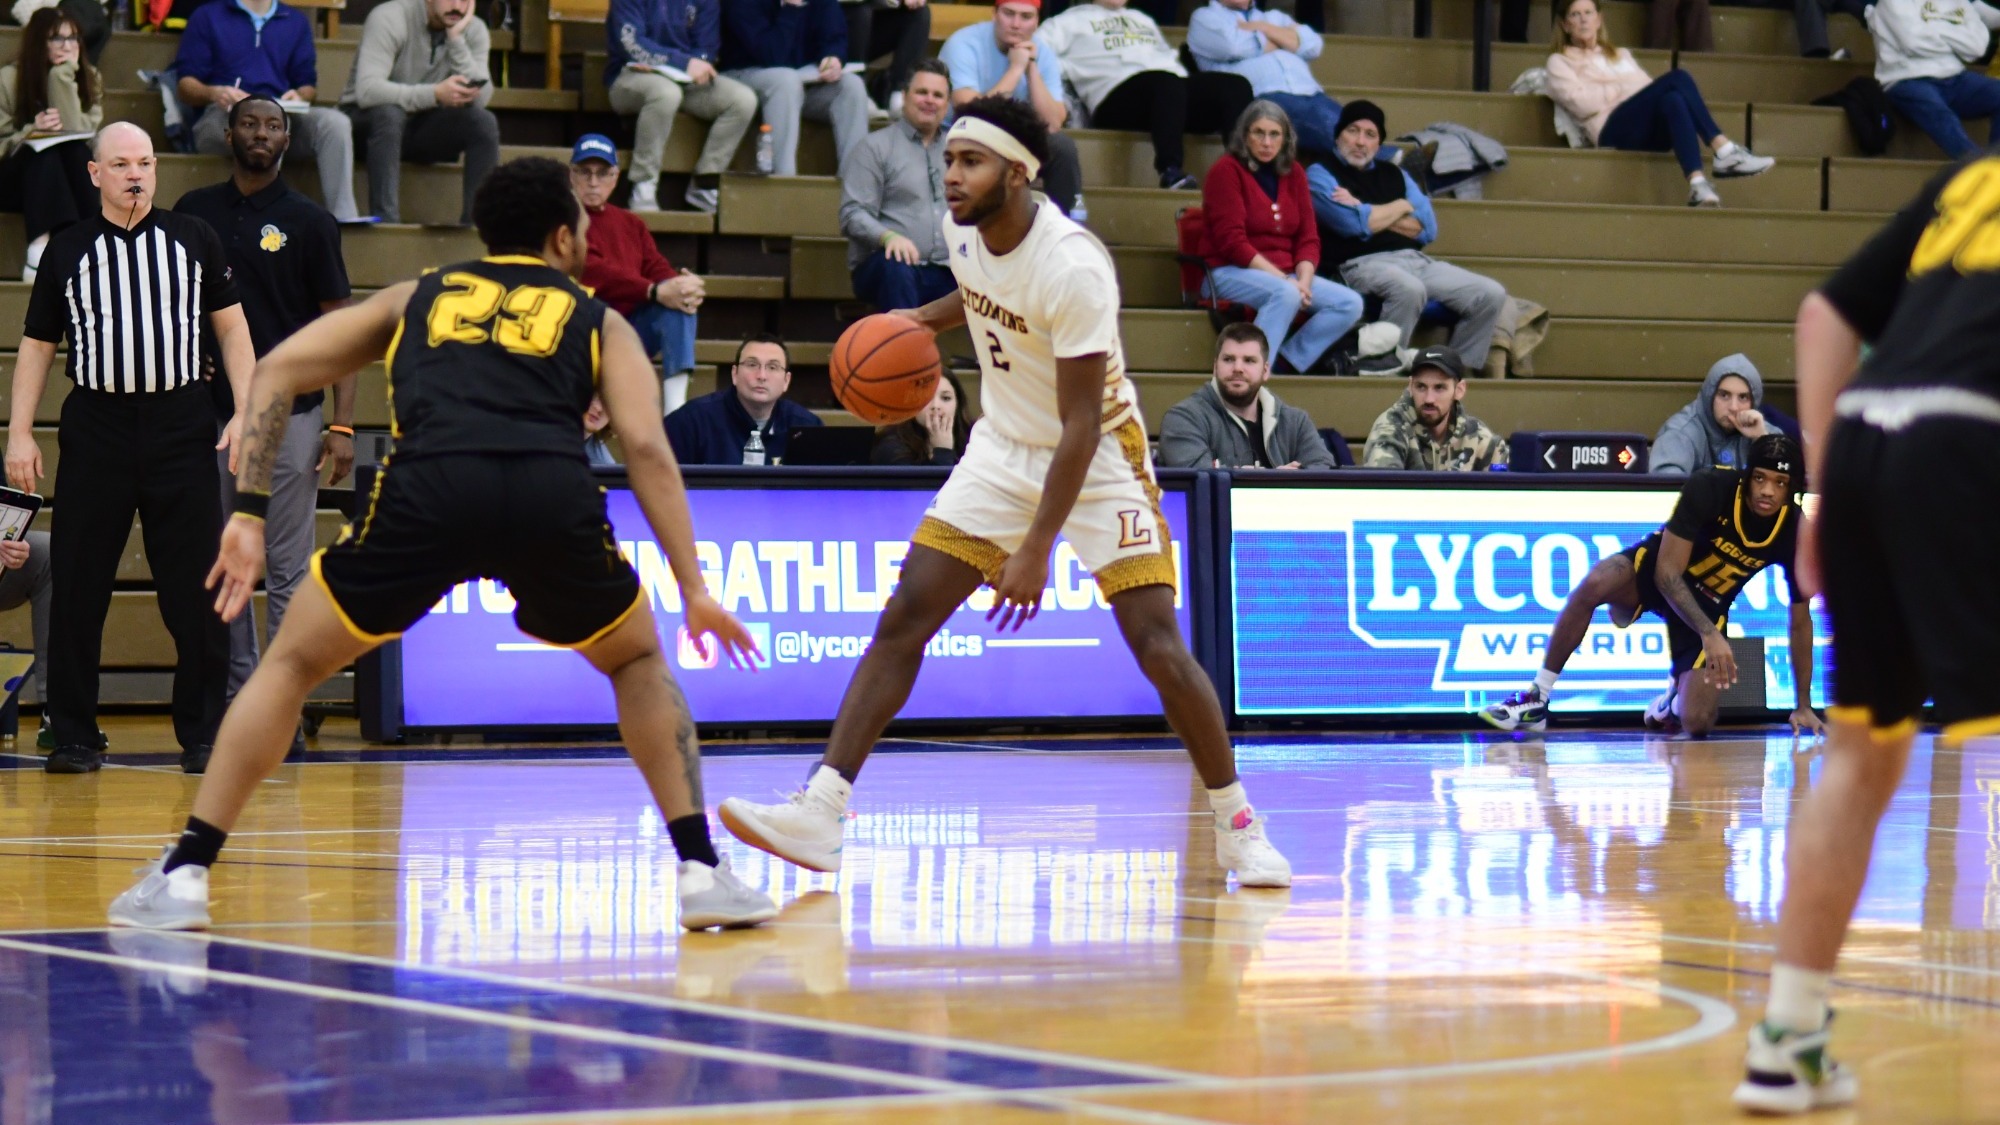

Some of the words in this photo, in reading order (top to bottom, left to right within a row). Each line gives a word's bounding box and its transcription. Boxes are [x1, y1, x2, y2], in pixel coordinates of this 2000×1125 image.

[427, 271, 577, 358] 23
[986, 330, 1010, 372] 2
[1571, 445, 1609, 470] poss
[1117, 509, 1151, 549] L
[1711, 536, 1766, 569] AGGIES
[1687, 552, 1750, 596] 15
